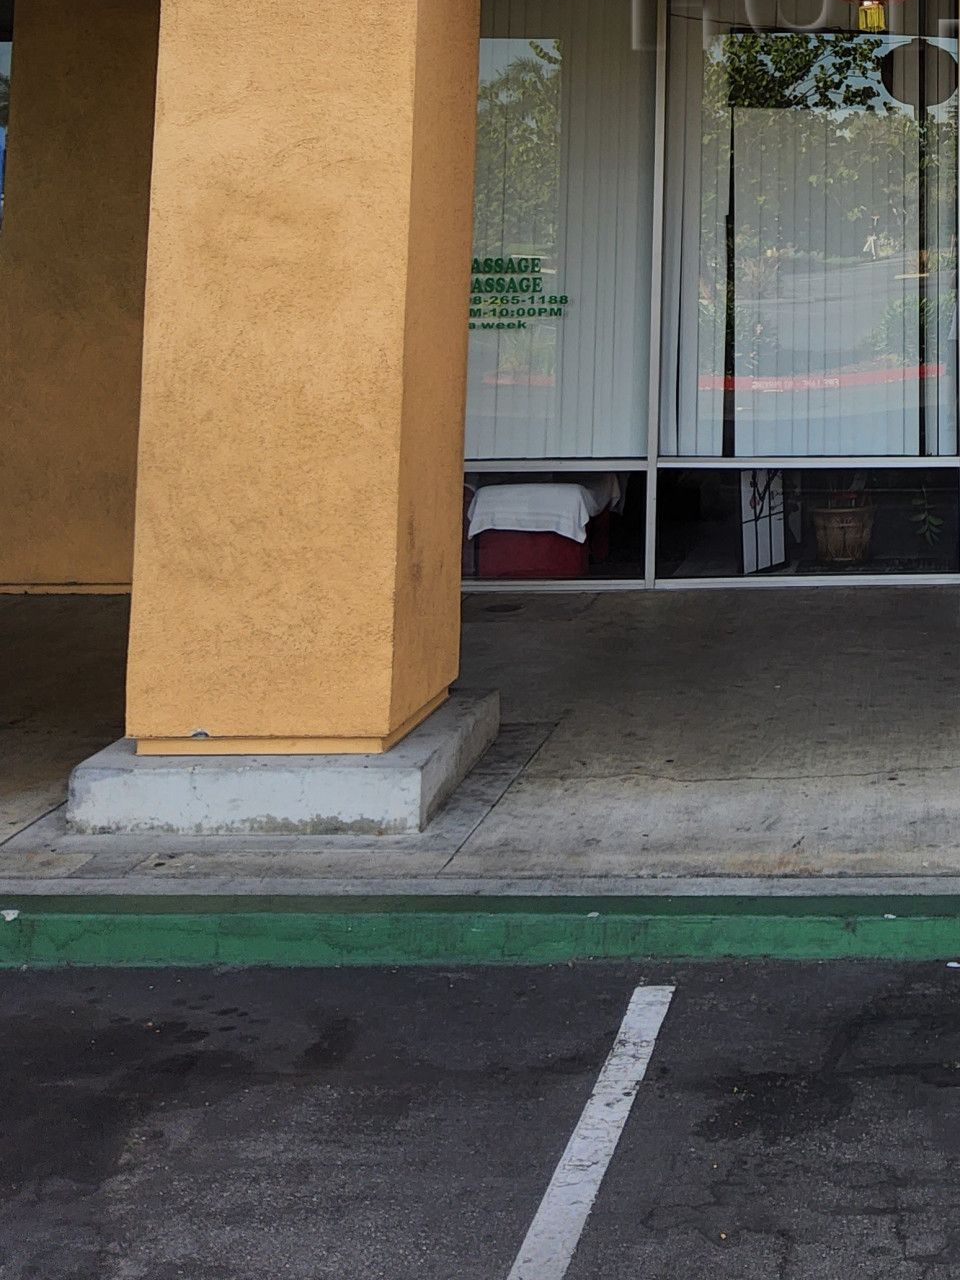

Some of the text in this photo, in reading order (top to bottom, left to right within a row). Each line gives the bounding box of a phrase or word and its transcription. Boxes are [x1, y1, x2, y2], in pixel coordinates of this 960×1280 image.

[471, 257, 542, 275] ASSAGE
[470, 277, 543, 294] ASSAGE
[470, 295, 569, 305] 8-265-1188
[469, 307, 562, 318] M-10:00PM
[481, 320, 527, 330] week
